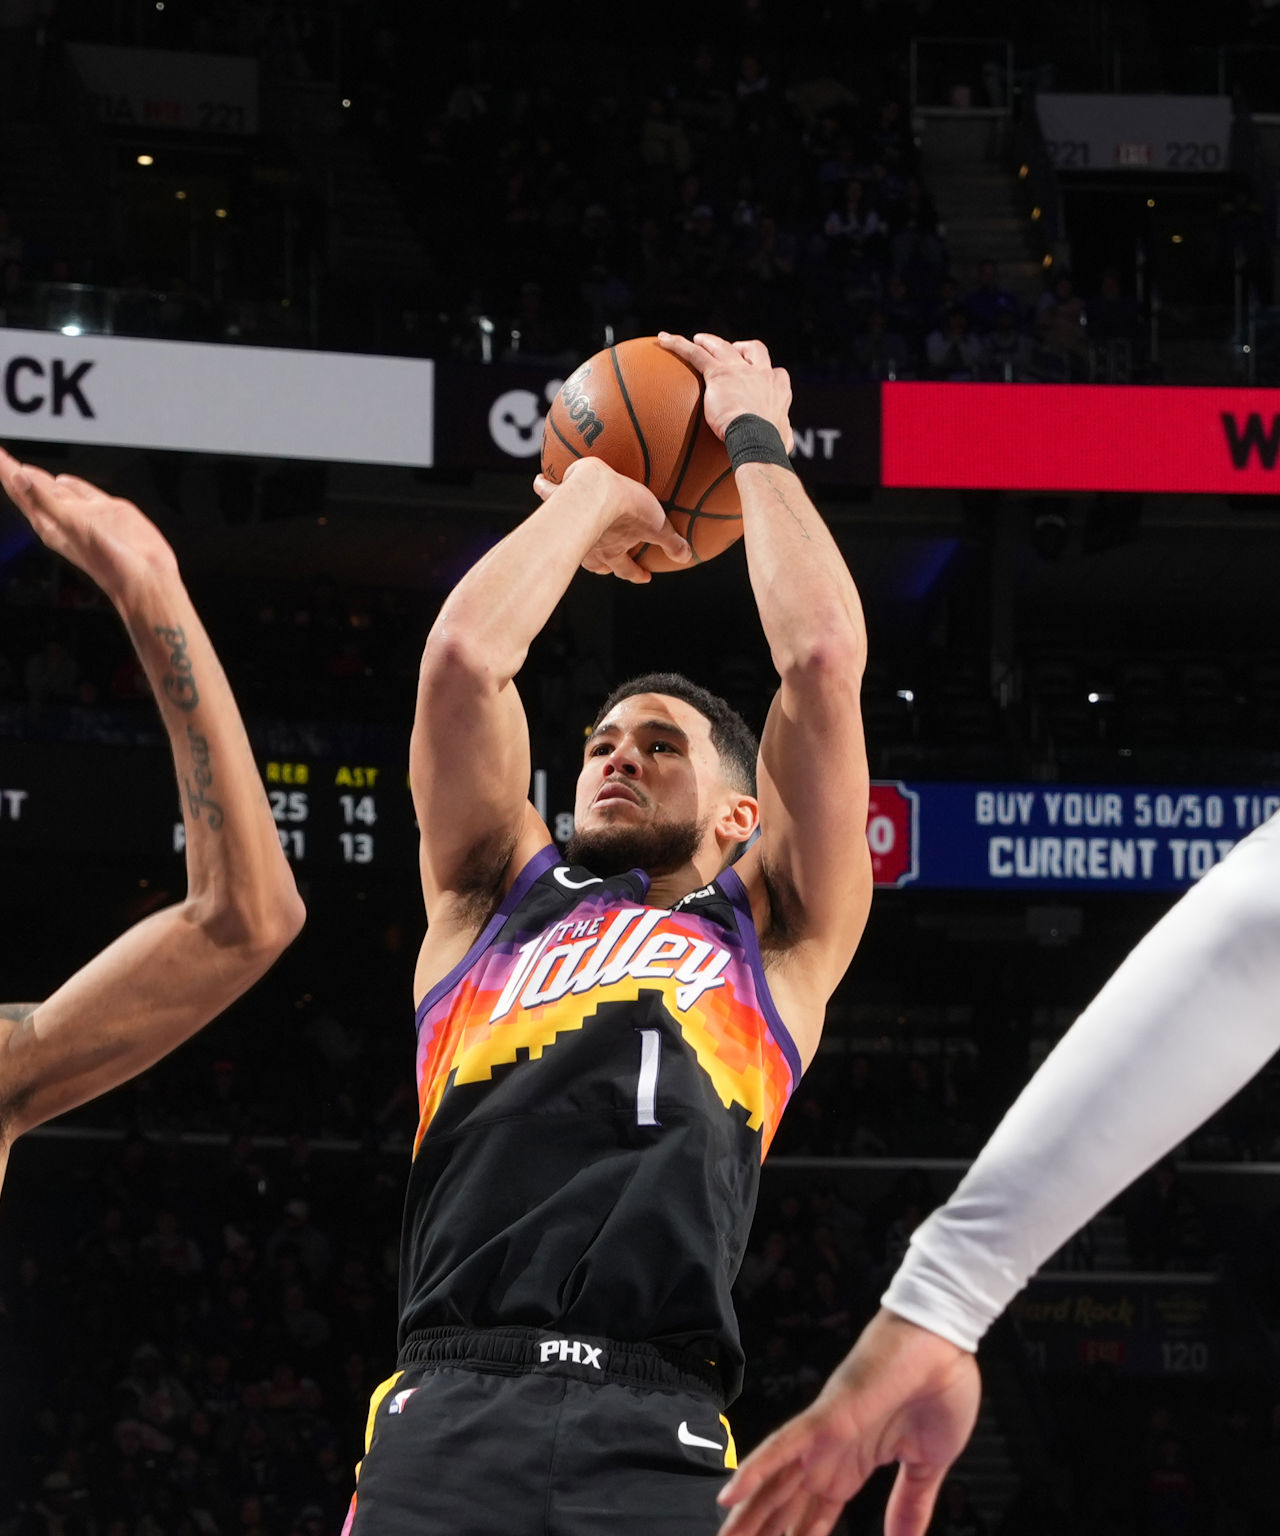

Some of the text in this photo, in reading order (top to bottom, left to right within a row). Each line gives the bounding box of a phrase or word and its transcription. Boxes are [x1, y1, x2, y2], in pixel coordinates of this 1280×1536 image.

[1165, 141, 1222, 168] 220
[266, 761, 380, 788] REB AST
[269, 790, 378, 827] 25 14
[975, 791, 1034, 826] BUY
[1054, 793, 1123, 828] YOUR
[1133, 795, 1223, 829] 50/50
[338, 832, 375, 864] 13
[989, 836, 1237, 880] CURRENT TOT
[674, 884, 716, 912] yPal
[557, 915, 605, 942] THE
[489, 908, 731, 1025] Valley
[635, 1027, 663, 1127] 1
[1073, 1294, 1135, 1328] Rock
[538, 1339, 603, 1369] PHX
[1161, 1342, 1209, 1373] 120
